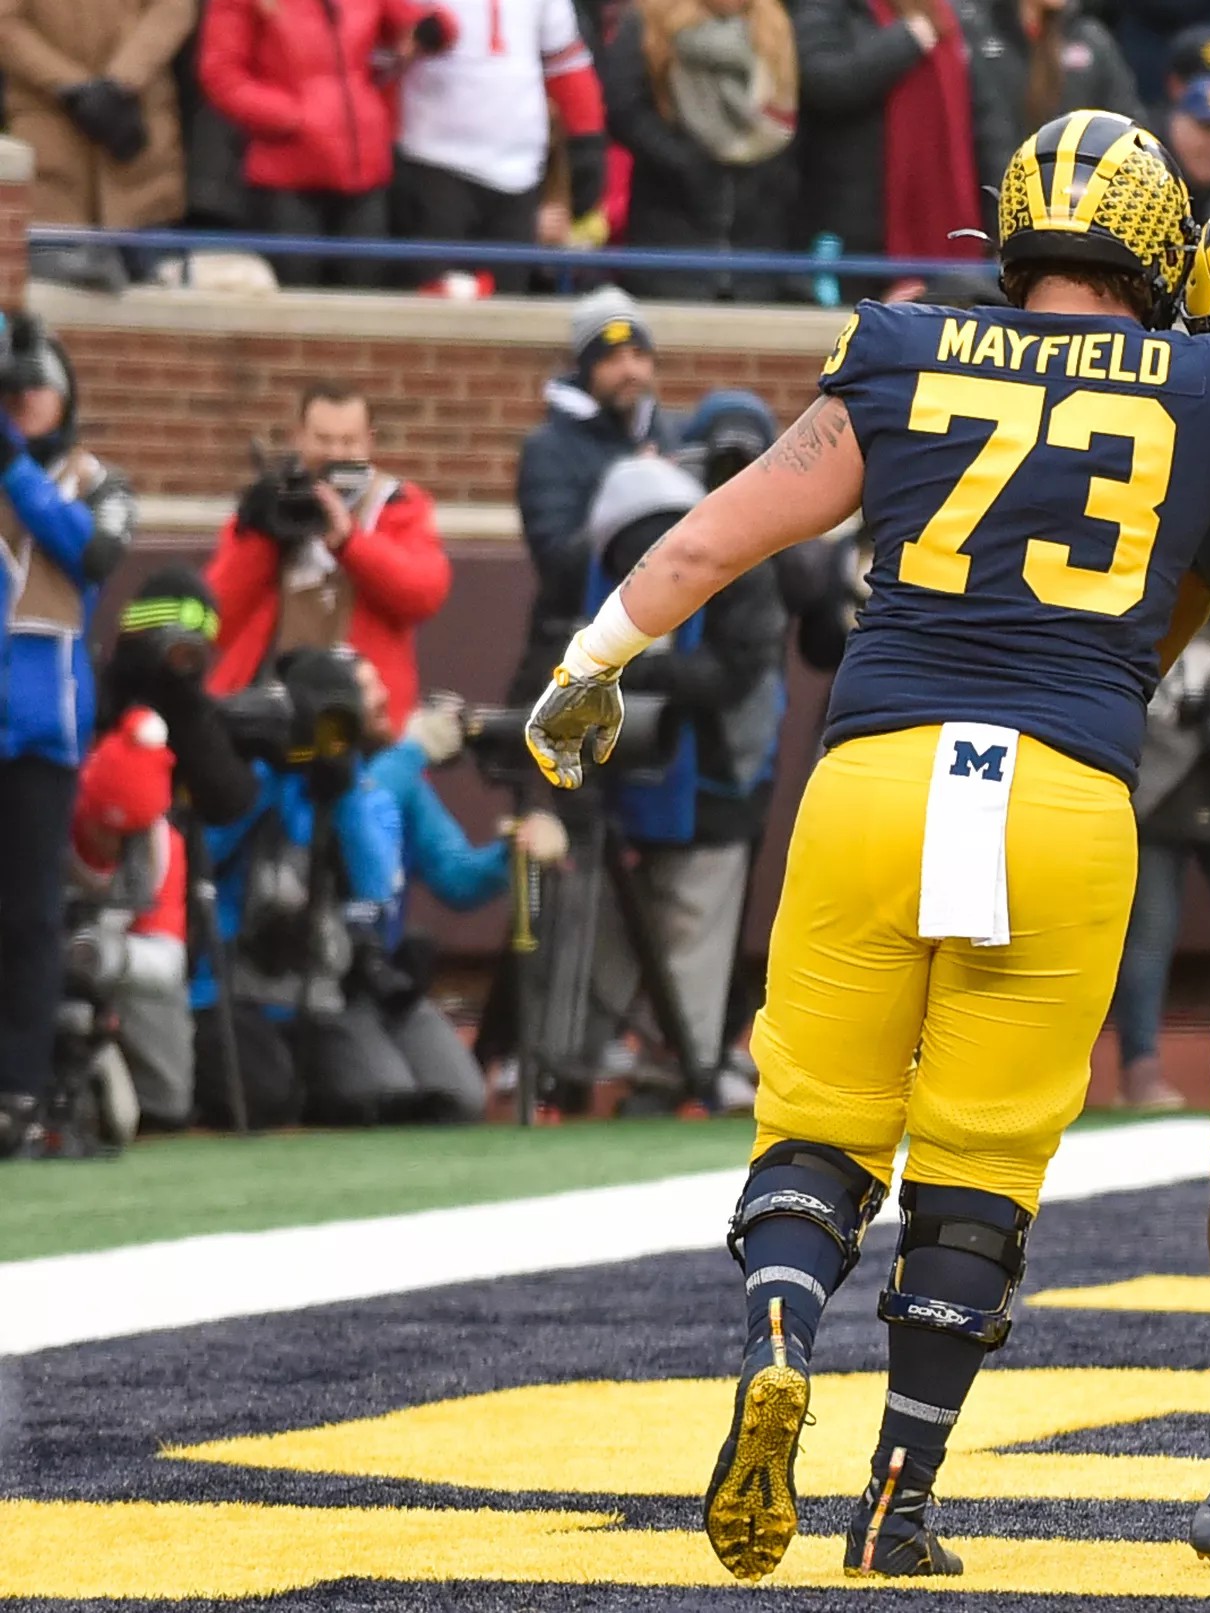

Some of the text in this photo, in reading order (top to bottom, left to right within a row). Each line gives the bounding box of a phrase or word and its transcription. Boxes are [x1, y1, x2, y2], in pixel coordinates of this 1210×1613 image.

[1017, 211, 1030, 229] 73
[936, 318, 1171, 385] MAYFIELD
[899, 371, 1177, 617] 73
[949, 740, 1008, 783] M
